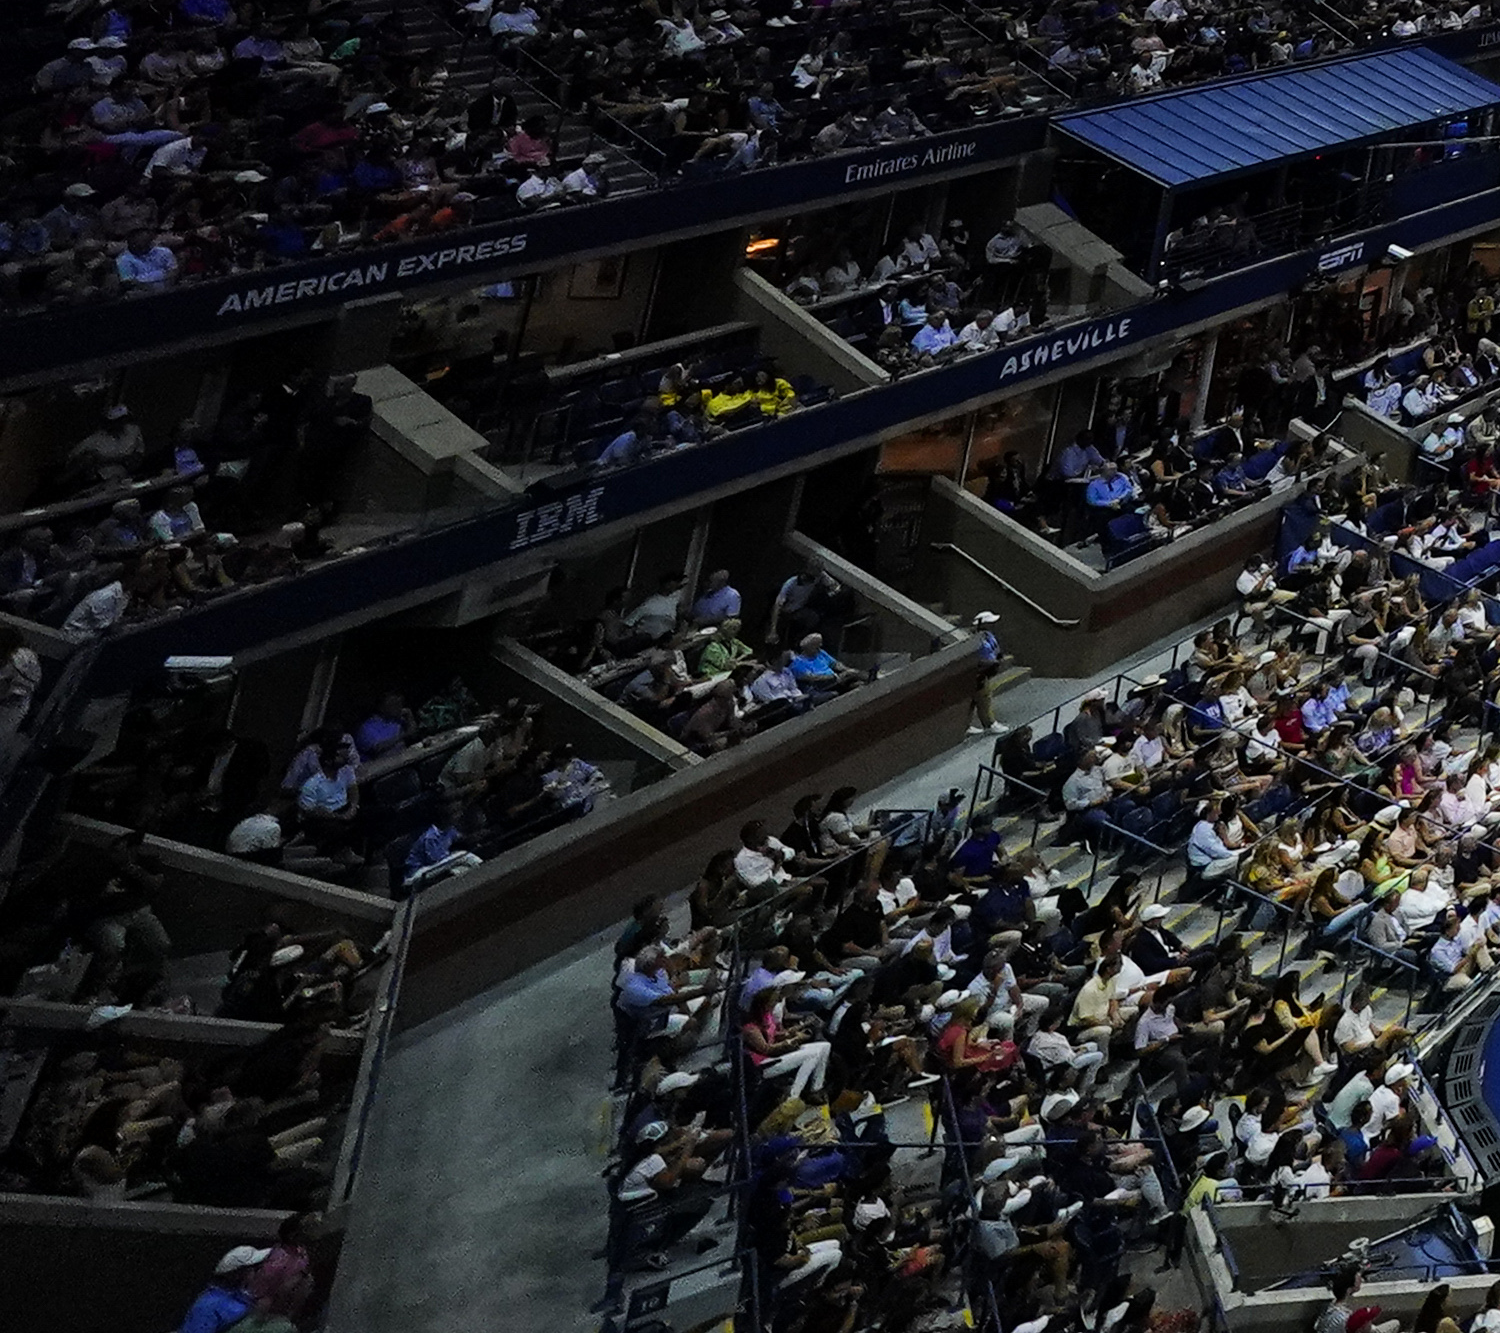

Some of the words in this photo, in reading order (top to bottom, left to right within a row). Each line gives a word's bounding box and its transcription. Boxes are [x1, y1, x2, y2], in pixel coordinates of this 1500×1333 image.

[844, 156, 918, 184] Emirates
[920, 141, 977, 167] Airline
[217, 263, 388, 315] AMERICAN
[396, 232, 528, 278] EXPRESS
[1317, 241, 1365, 271] ESPN
[509, 485, 605, 551] IBM
